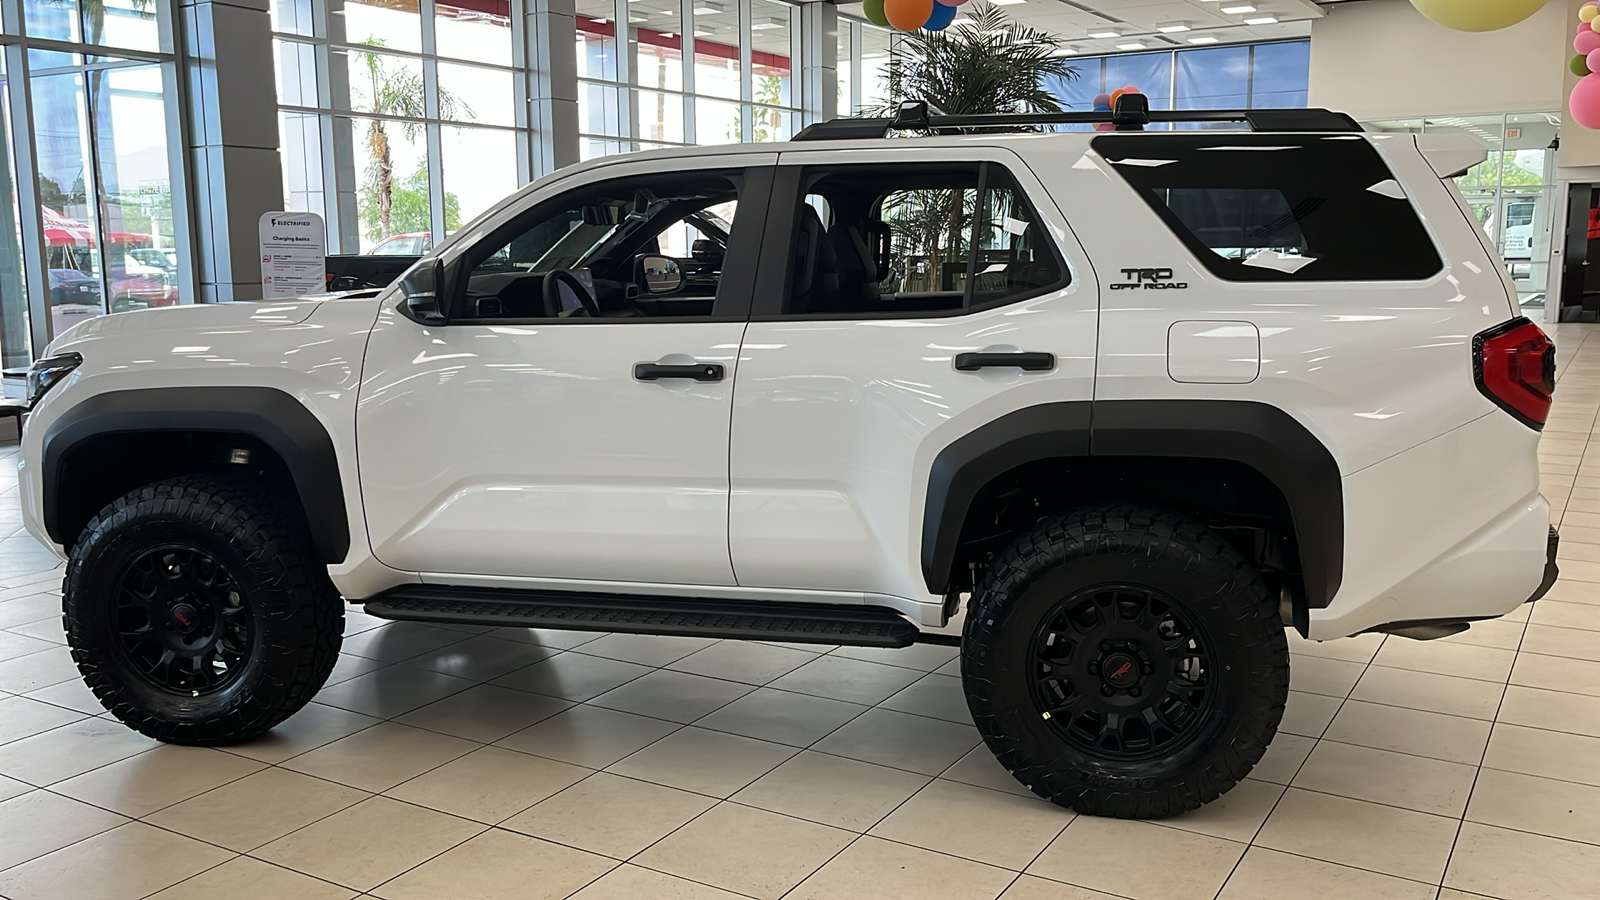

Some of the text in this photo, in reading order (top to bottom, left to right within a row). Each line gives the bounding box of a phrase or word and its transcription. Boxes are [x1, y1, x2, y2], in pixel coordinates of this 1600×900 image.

[1120, 268, 1173, 283] TRD
[1144, 282, 1188, 290] ROAD
[1110, 661, 1132, 680] TRD
